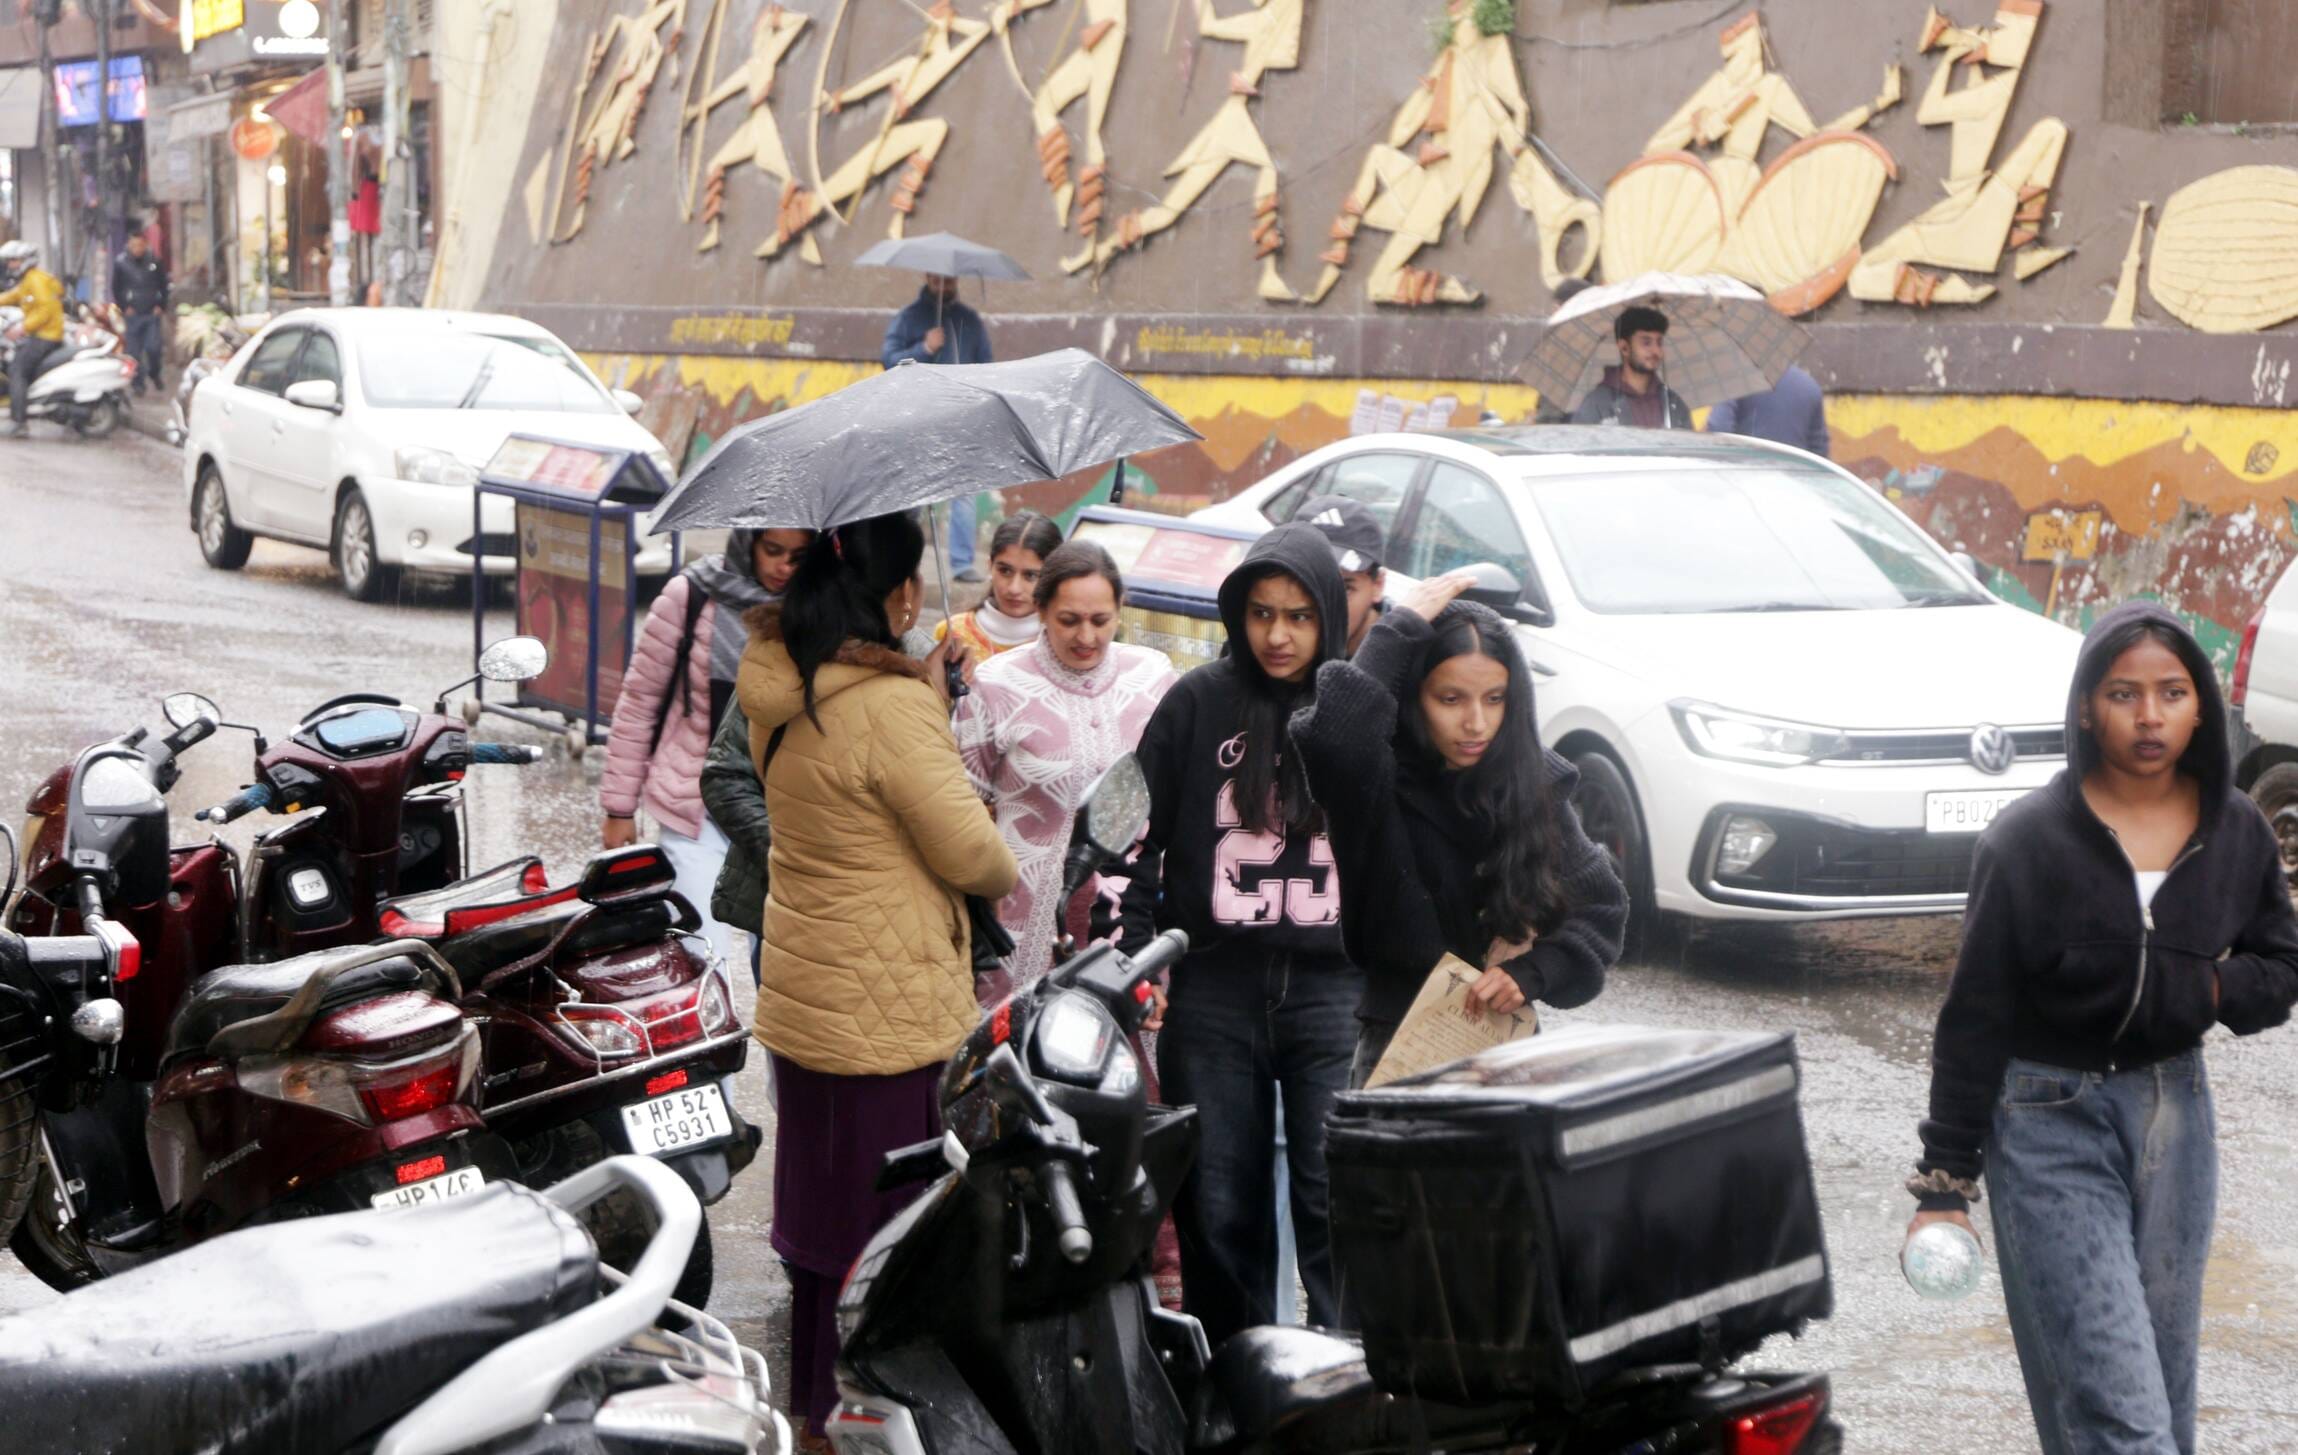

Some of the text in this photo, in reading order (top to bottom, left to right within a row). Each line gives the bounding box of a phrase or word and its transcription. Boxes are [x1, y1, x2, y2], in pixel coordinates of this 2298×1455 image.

[1943, 799, 2006, 825] PB02
[299, 879, 321, 892] TVS
[648, 1090, 708, 1124] HP 52
[653, 1112, 716, 1148] C5931
